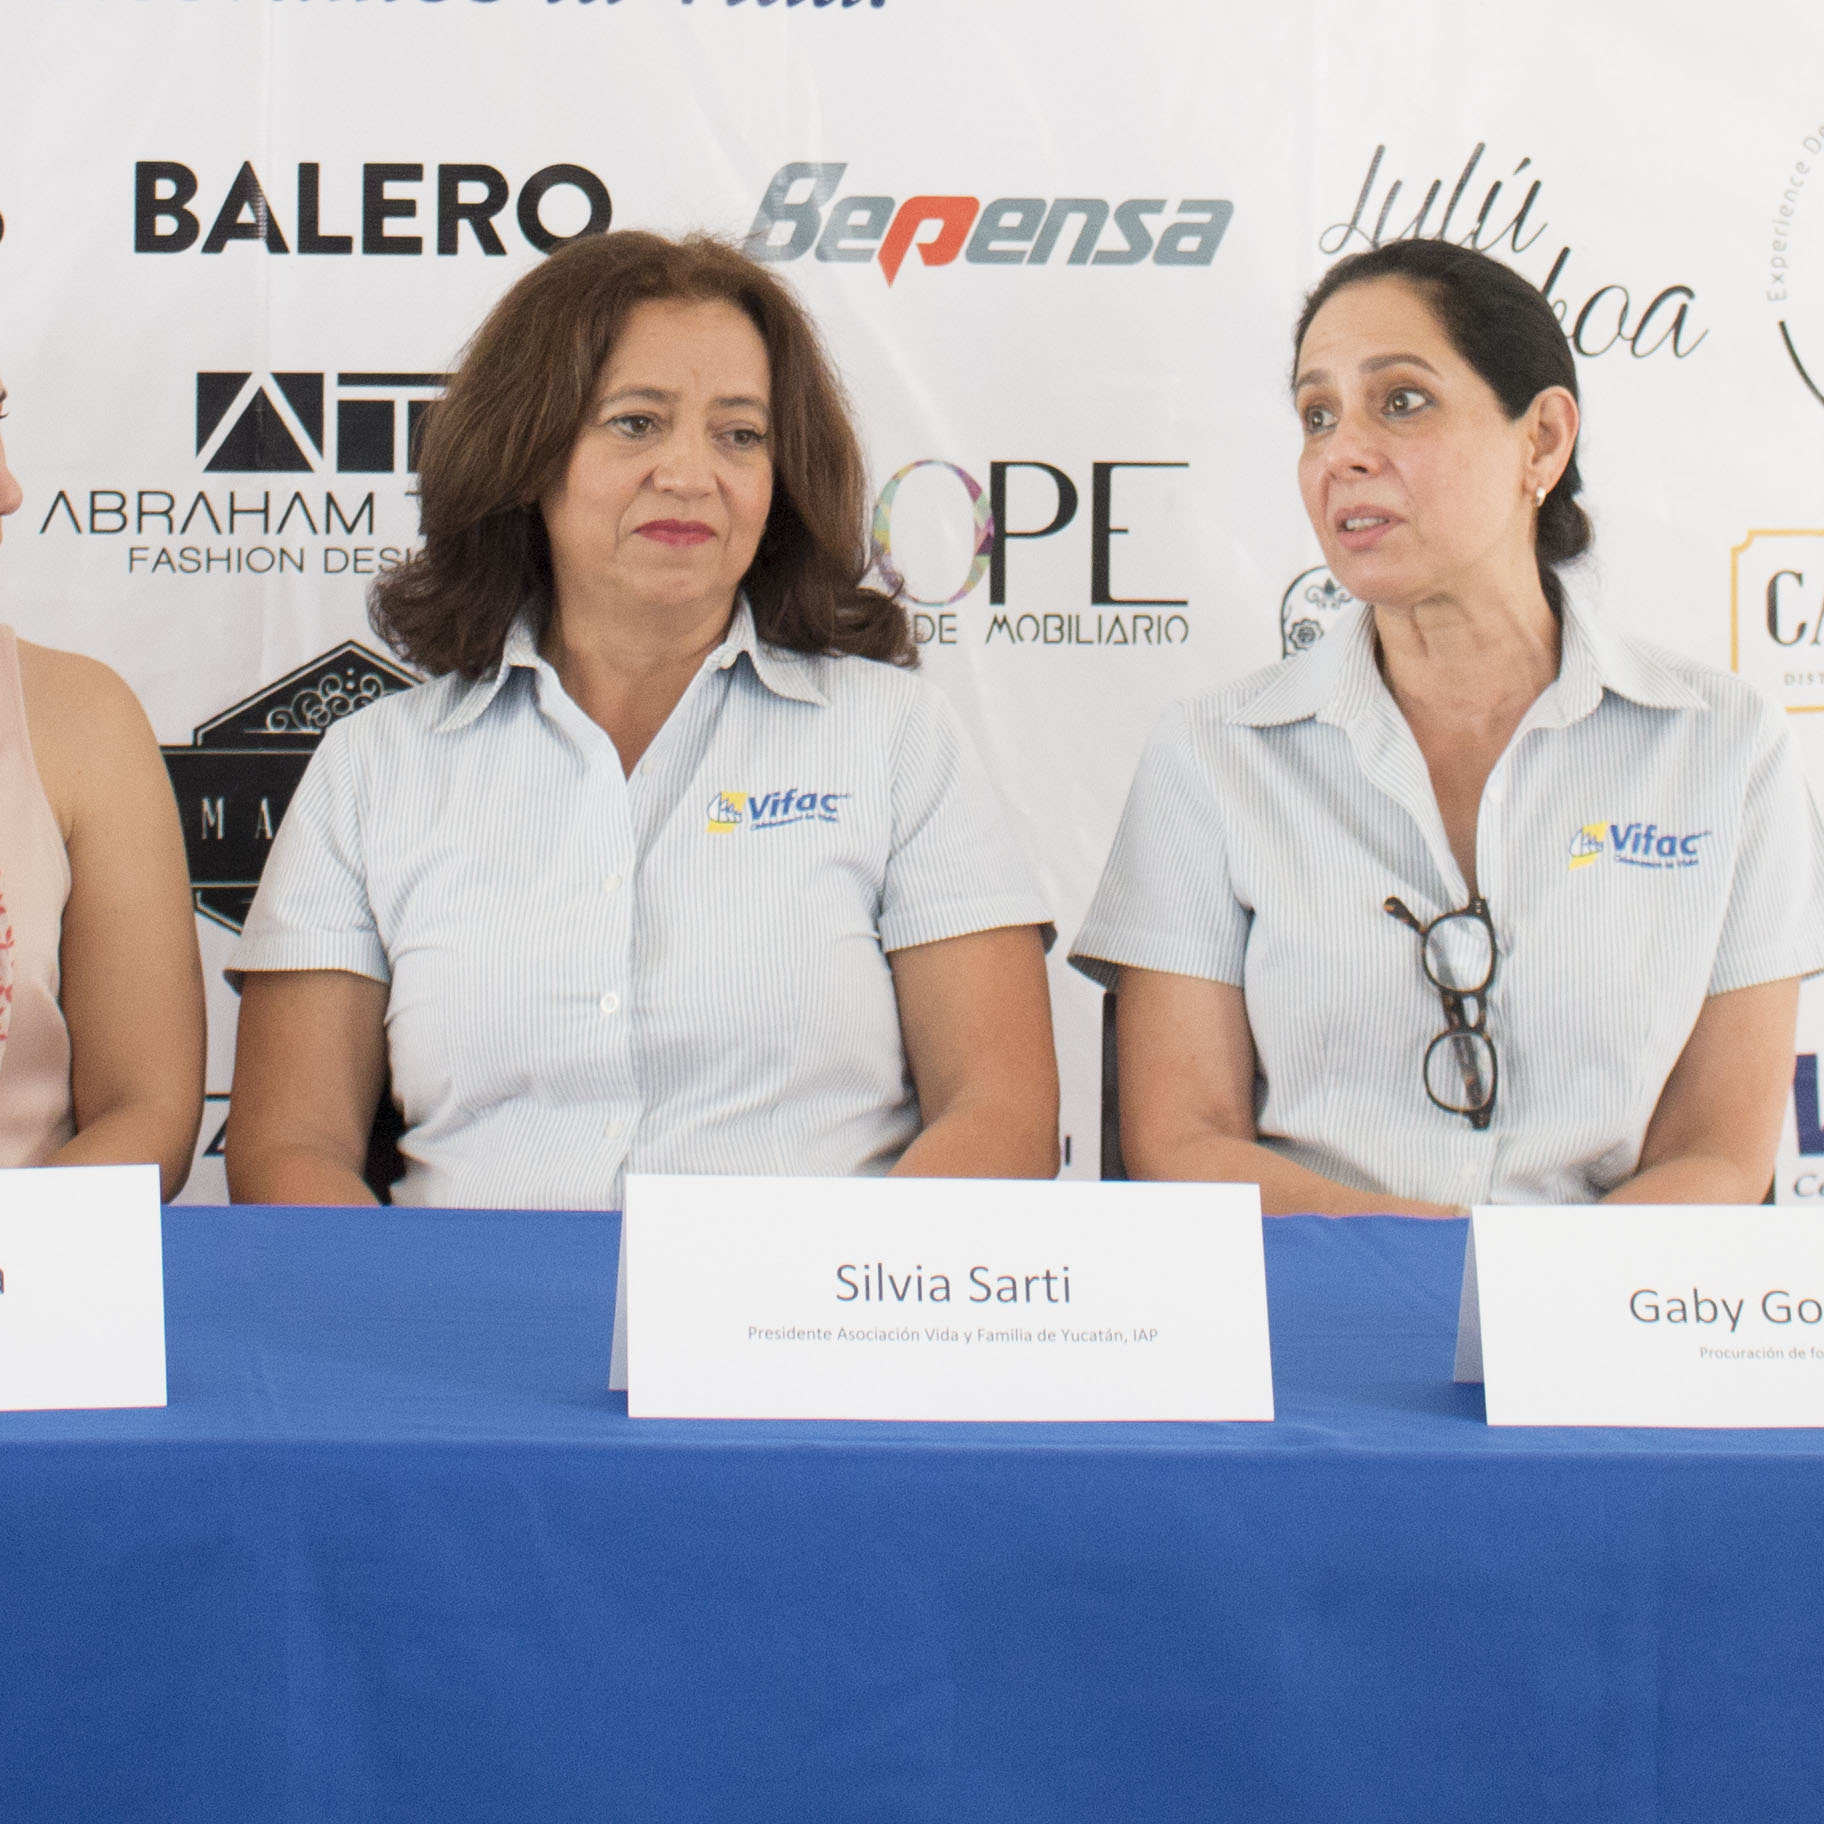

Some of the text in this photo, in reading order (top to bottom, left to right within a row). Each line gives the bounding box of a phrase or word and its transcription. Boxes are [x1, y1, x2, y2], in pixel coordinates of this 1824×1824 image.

[132, 161, 613, 256] BALERO
[745, 162, 1234, 286] Bepensa
[40, 490, 374, 535] ABRAHAM
[129, 547, 304, 574] FASHION
[986, 613, 1188, 645] MOBILIARIO
[749, 789, 838, 819] Vifac
[1611, 824, 1697, 857] Vifac
[837, 1262, 1070, 1303] Silvia Sarti
[1630, 1288, 1744, 1333] Gaby
[749, 1326, 1158, 1346] Presidente Asociación Vida y Familia de Yucatán, IAP
[1700, 1345, 1788, 1360] Procuración
[1792, 1345, 1805, 1360] de
